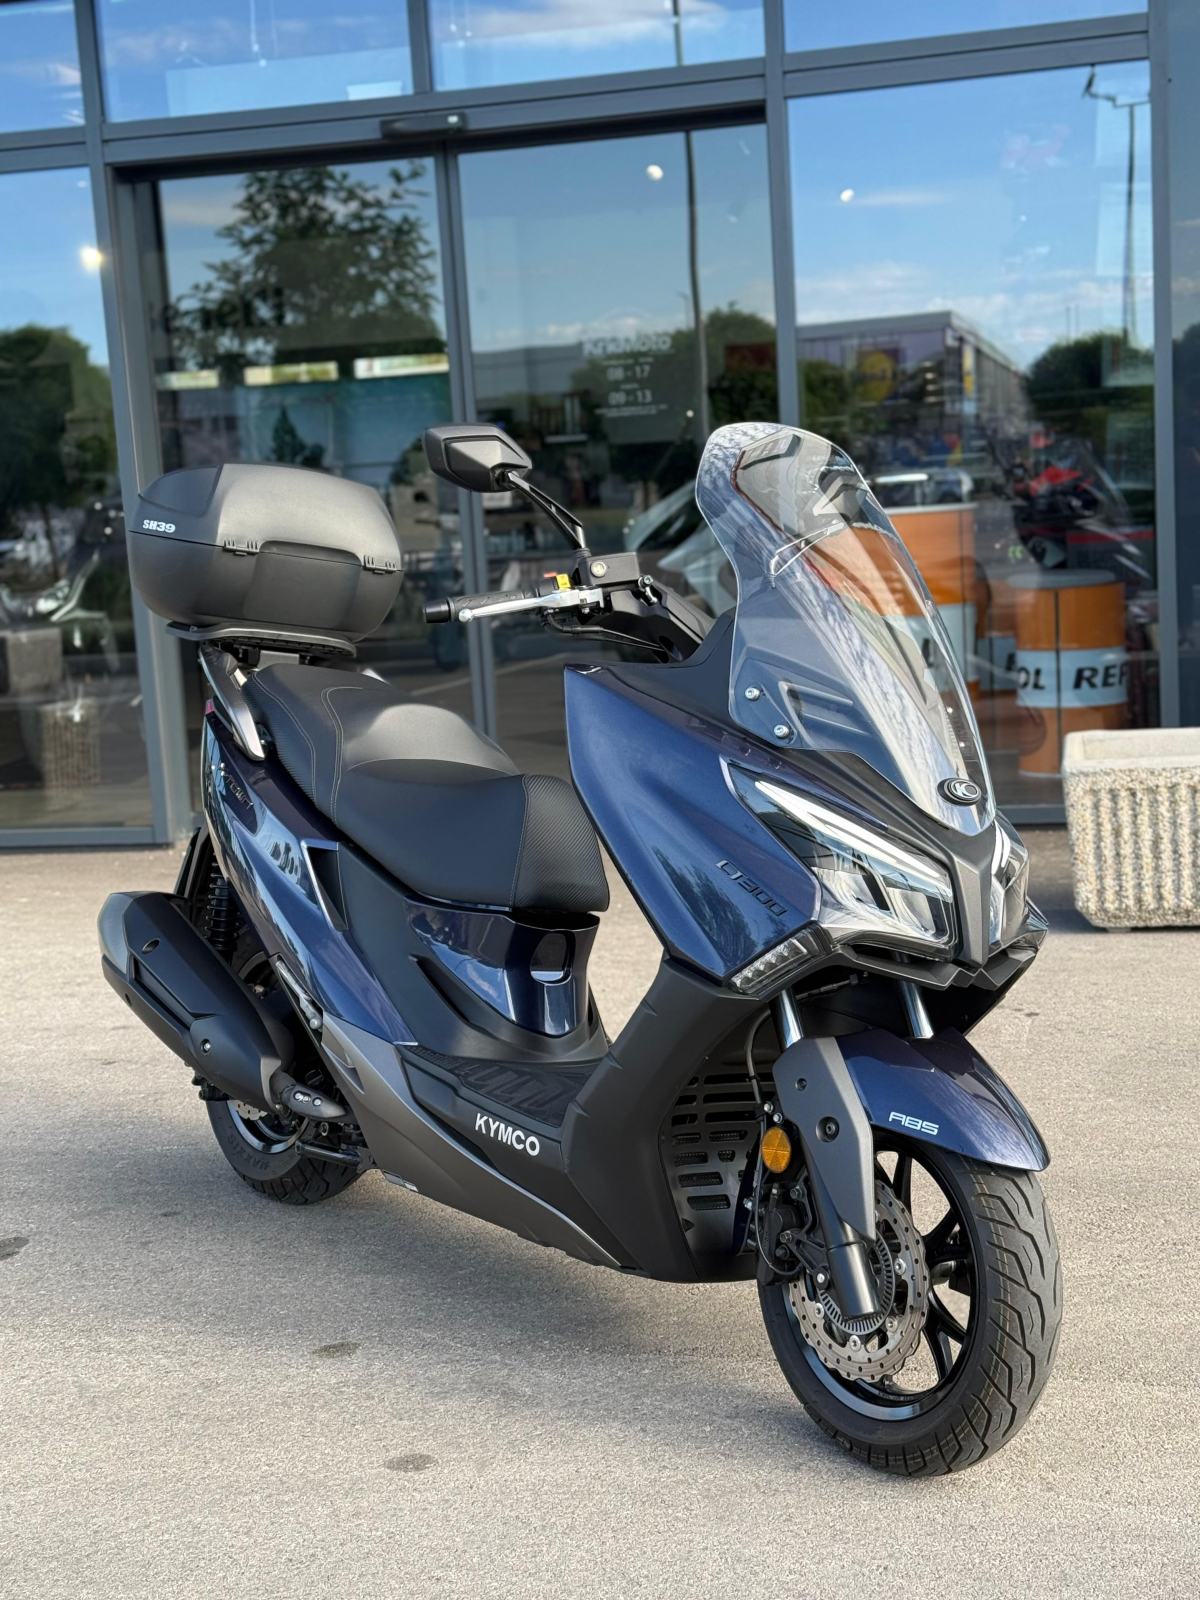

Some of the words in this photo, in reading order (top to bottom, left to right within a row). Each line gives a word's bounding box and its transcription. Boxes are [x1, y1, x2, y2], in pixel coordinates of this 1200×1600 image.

[142, 519, 176, 533] SH39
[475, 1112, 540, 1157] KYMCO
[888, 1111, 940, 1136] ABS
